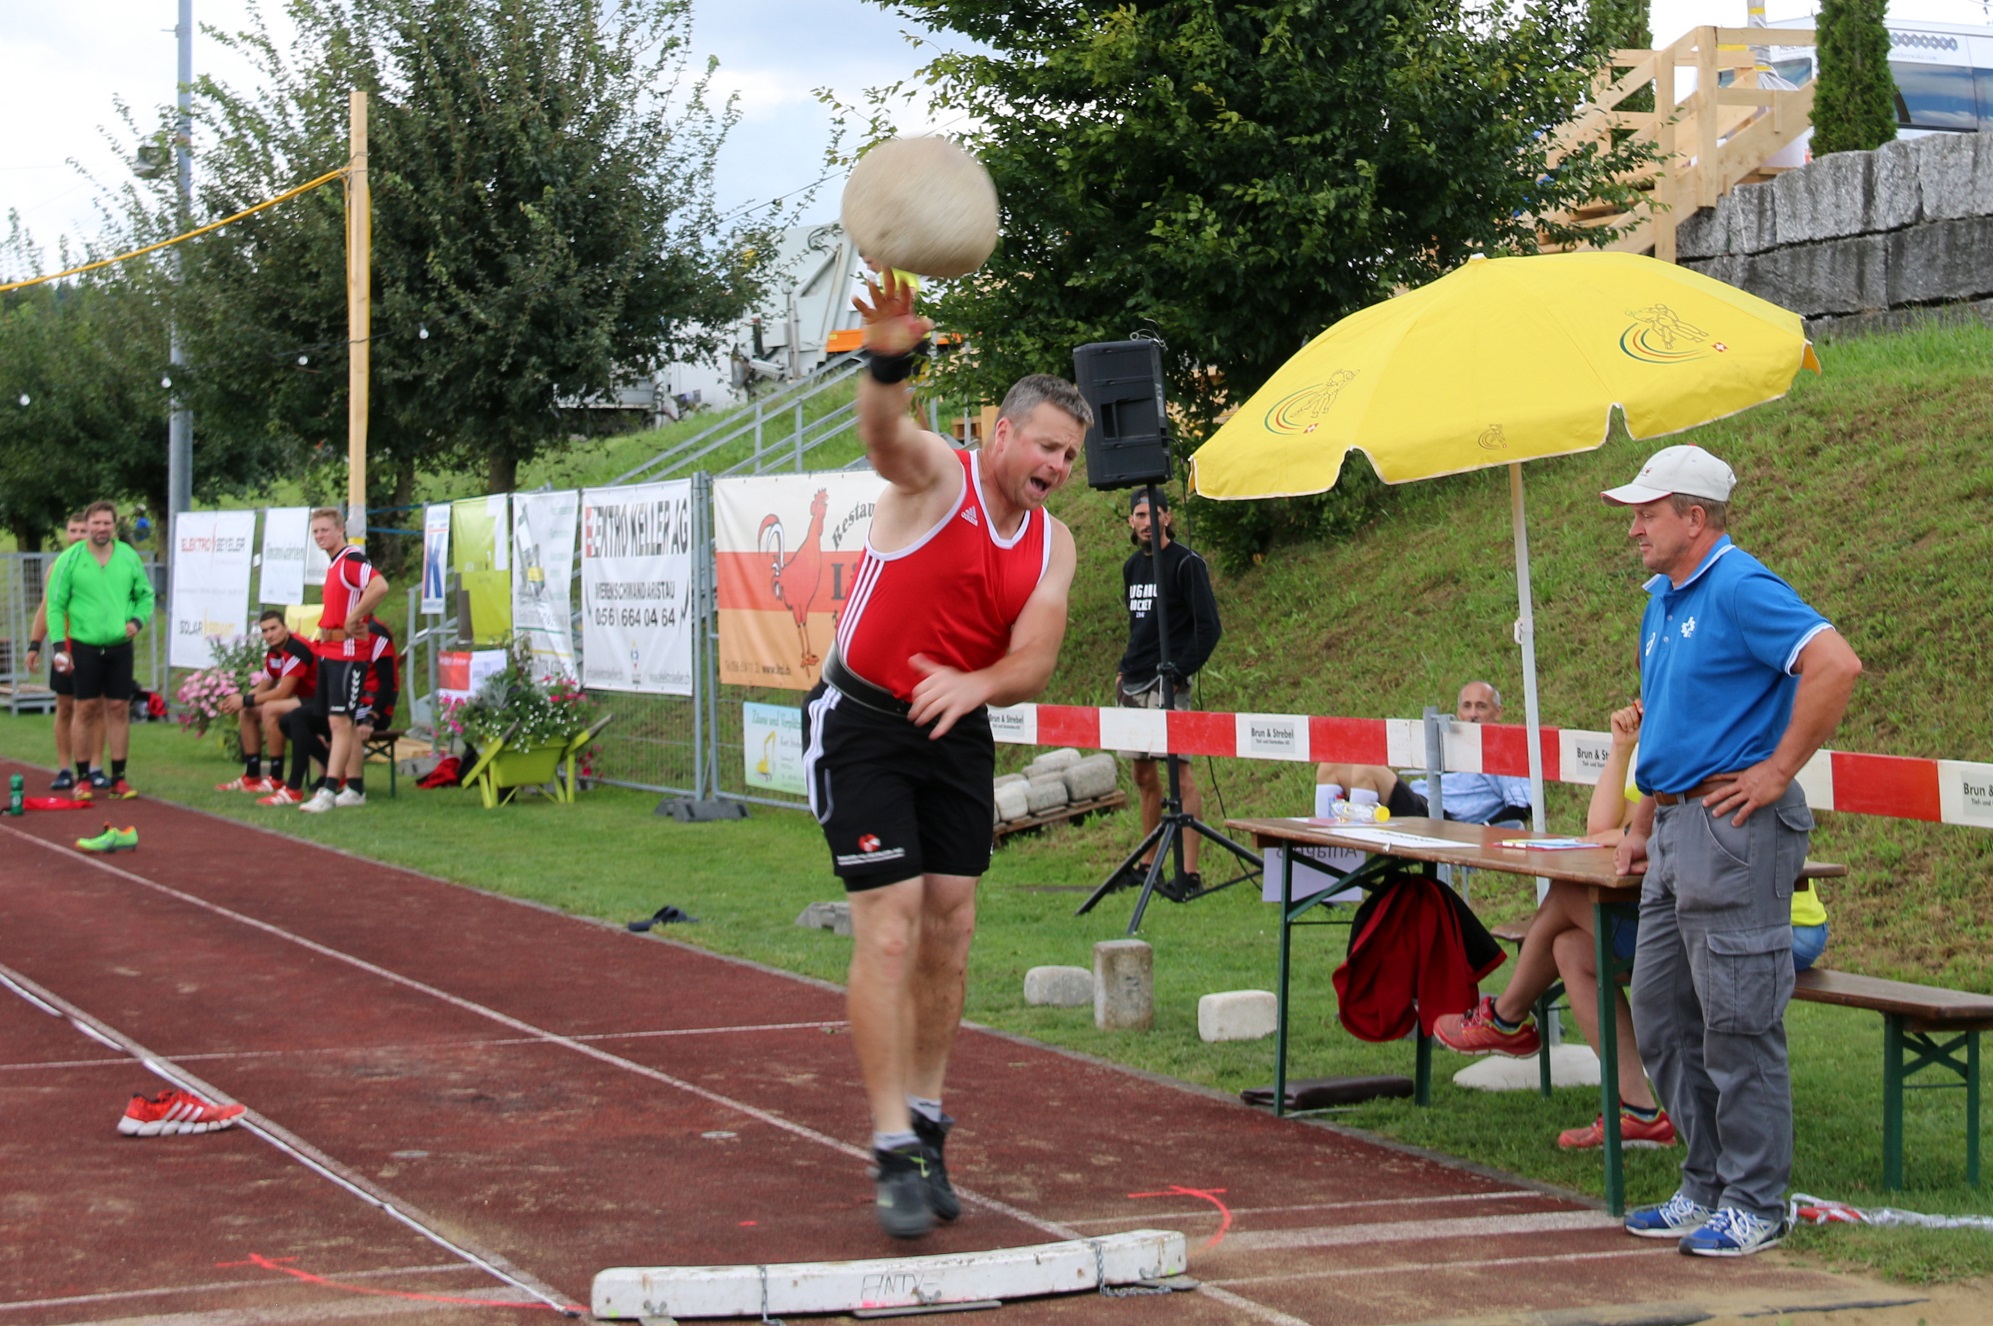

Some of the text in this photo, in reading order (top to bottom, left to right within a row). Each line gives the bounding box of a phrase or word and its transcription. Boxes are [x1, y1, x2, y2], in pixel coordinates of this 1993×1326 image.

[631, 501, 670, 557] KELLER
[671, 498, 688, 555] AG
[595, 606, 676, 627] 056 664 04 64
[1251, 727, 1294, 739] Brun & Strebel
[1577, 747, 1593, 759] Brun
[1594, 748, 1600, 760] &
[1963, 782, 1986, 796] Brun
